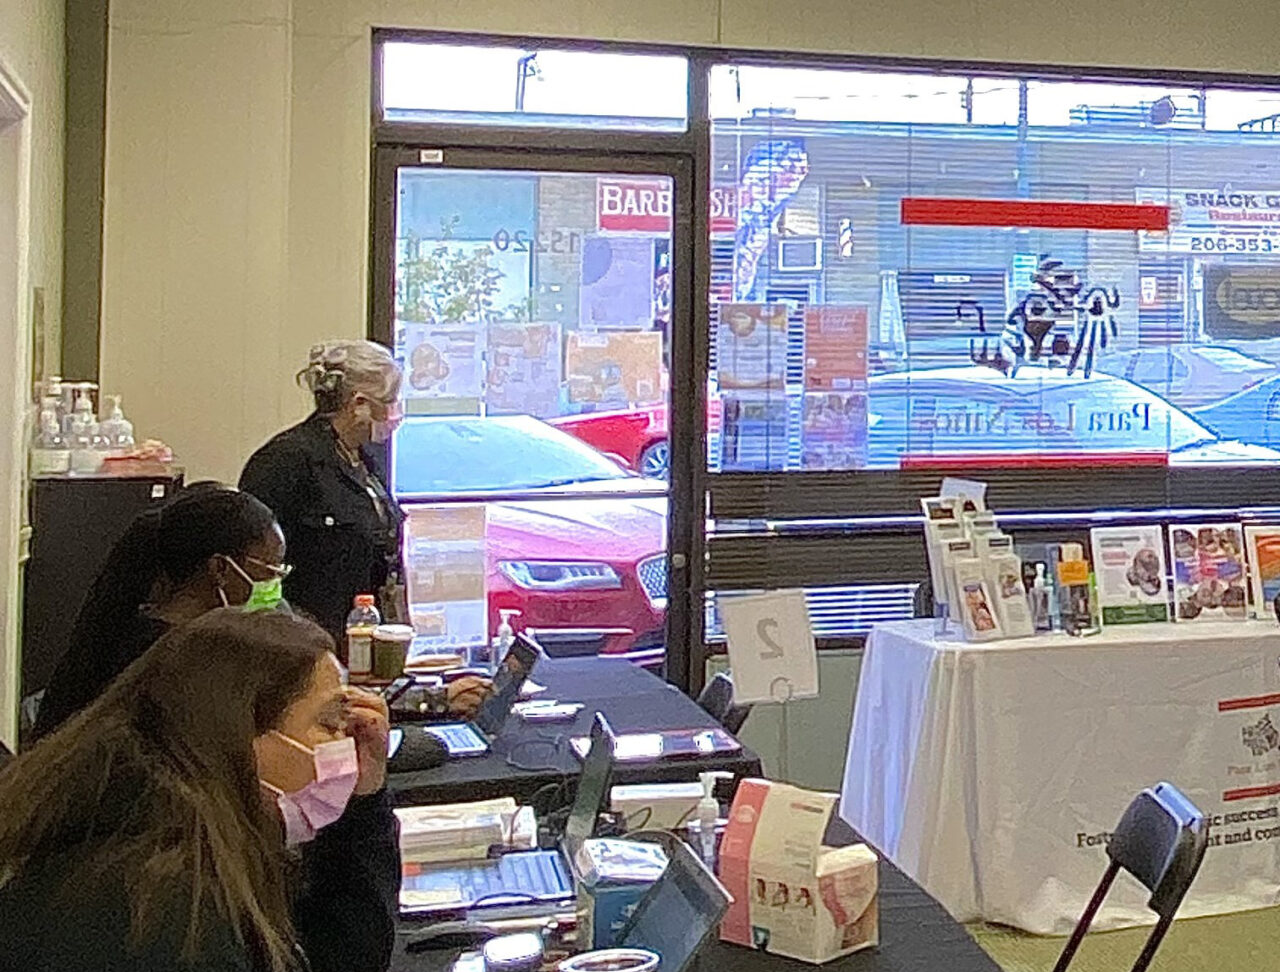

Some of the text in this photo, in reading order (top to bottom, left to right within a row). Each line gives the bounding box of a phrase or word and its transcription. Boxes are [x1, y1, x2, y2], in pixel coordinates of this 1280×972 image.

[1185, 192, 1258, 208] SNACK
[1223, 806, 1279, 827] success
[1224, 827, 1252, 844] and
